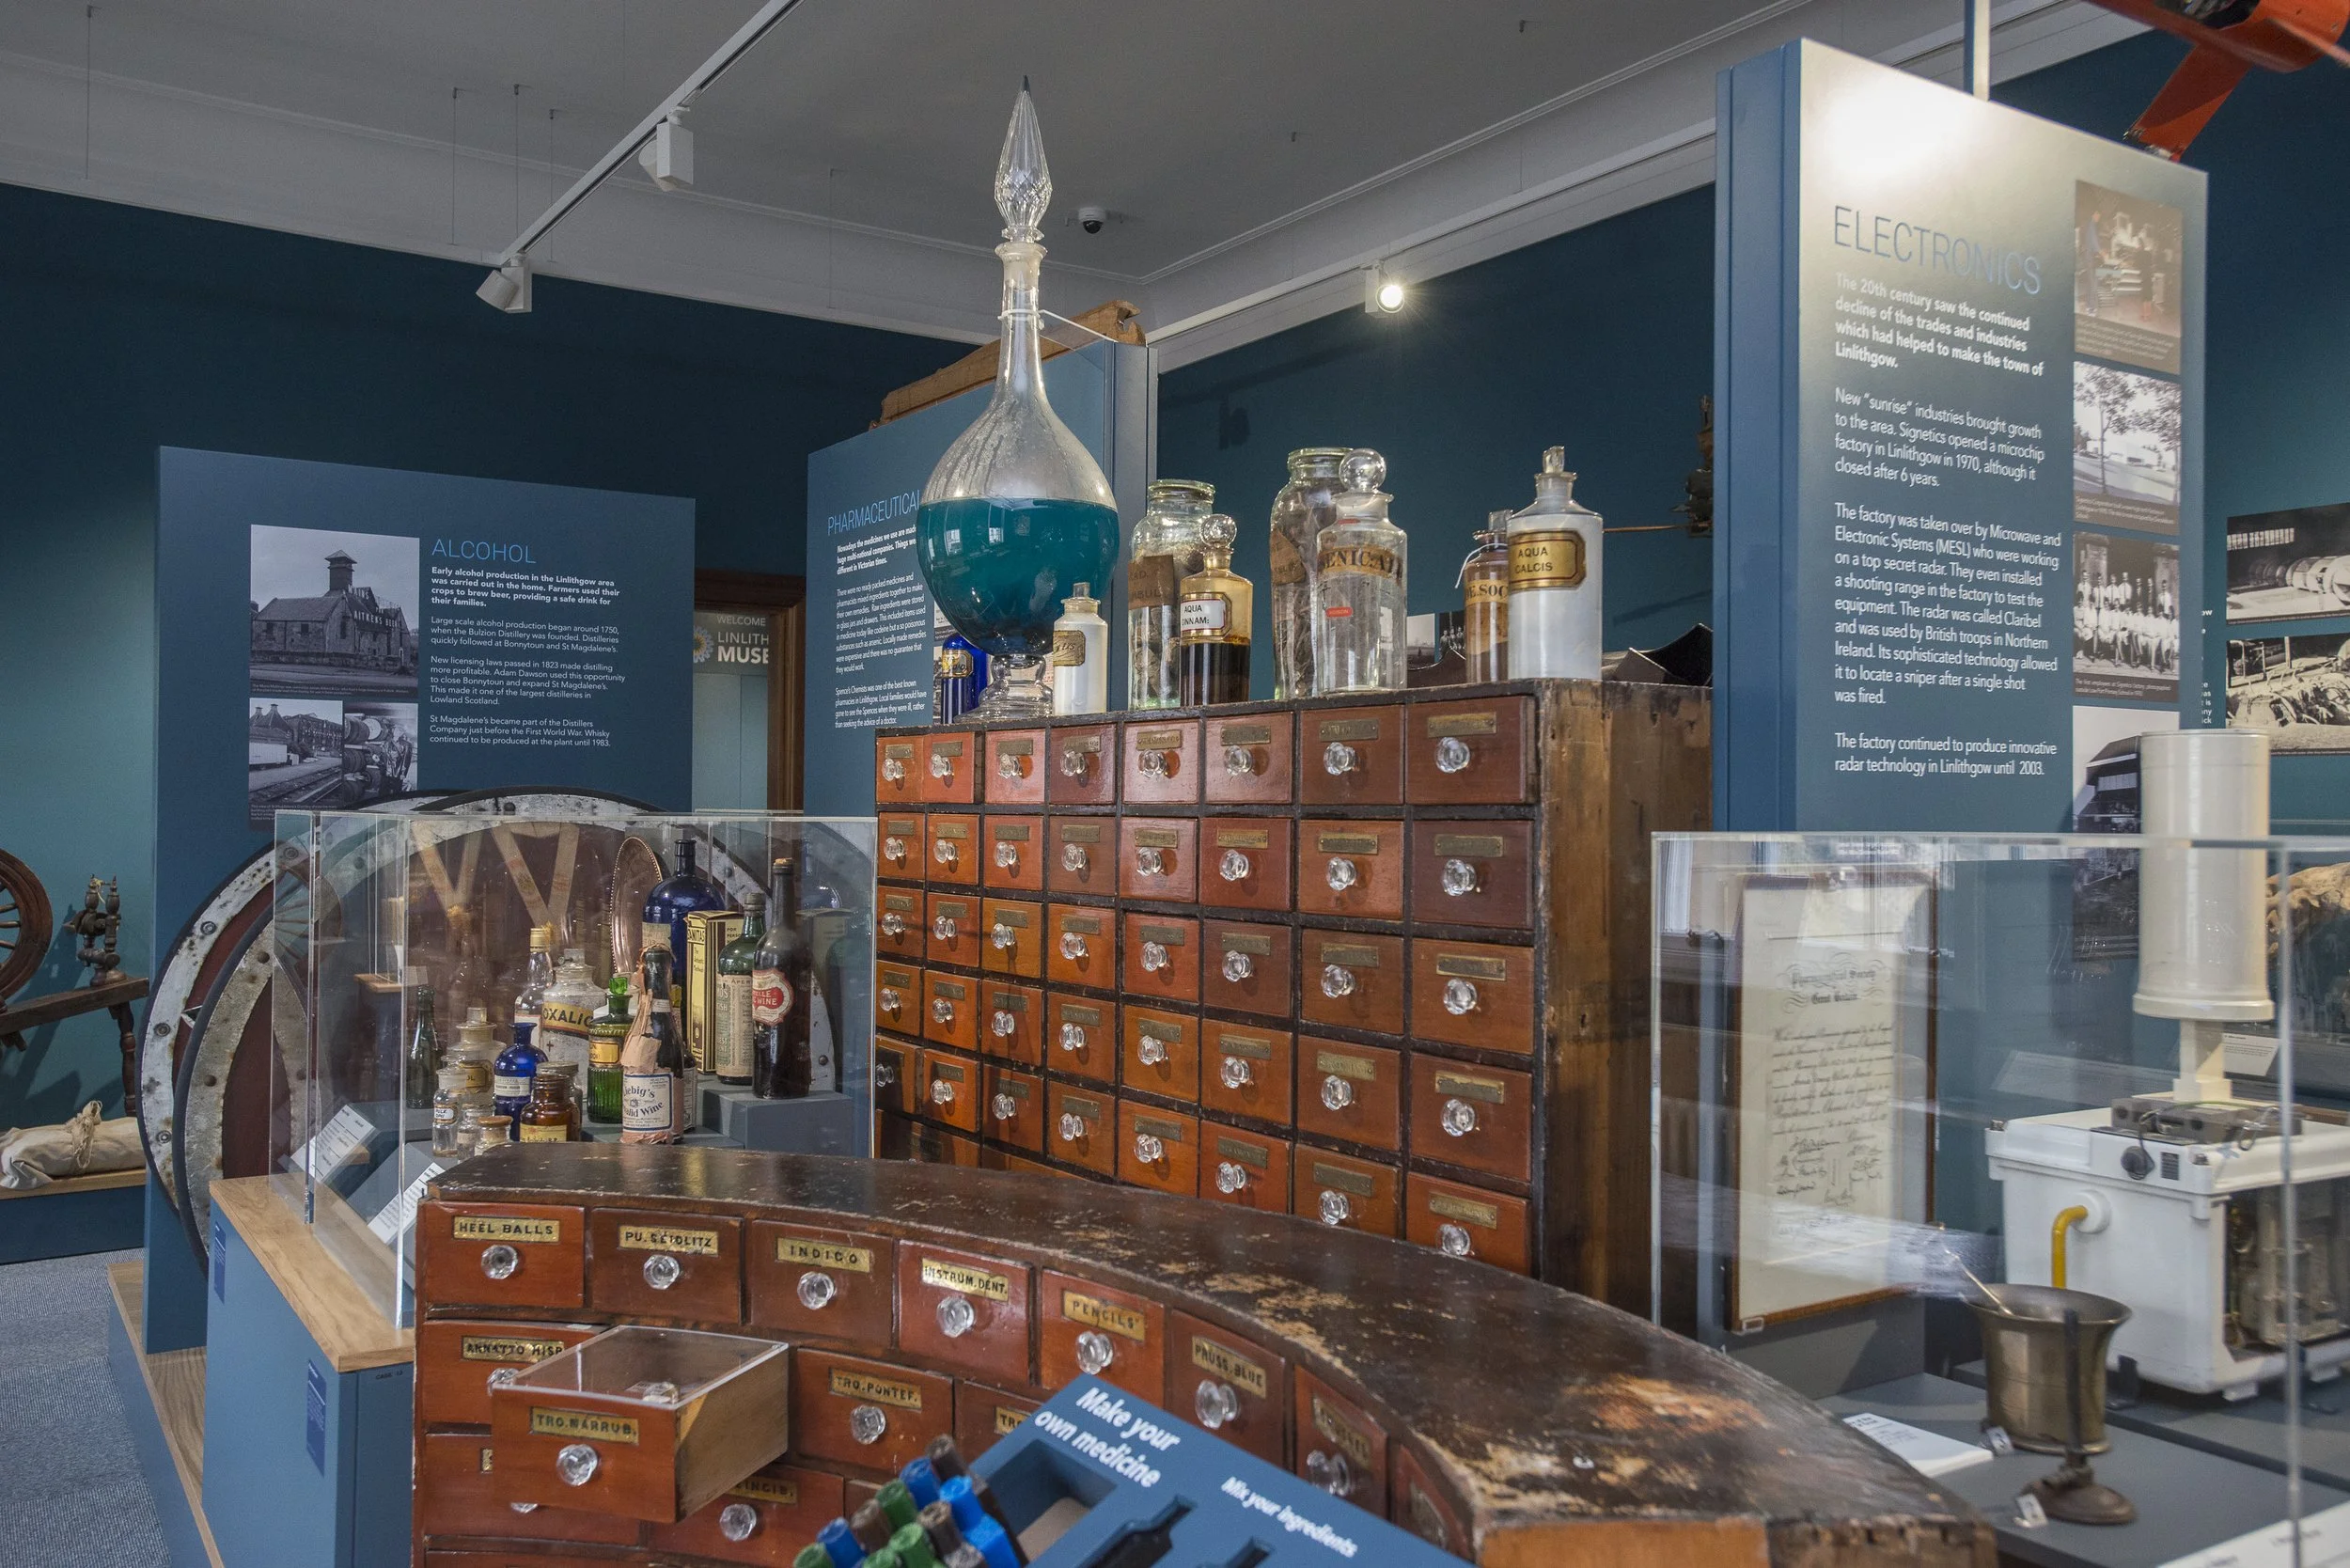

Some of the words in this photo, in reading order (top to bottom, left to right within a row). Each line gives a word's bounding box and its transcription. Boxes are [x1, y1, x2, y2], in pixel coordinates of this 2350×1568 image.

[1834, 204, 2042, 294] ELECTRONICS
[1835, 272, 1856, 290] The
[1860, 278, 1887, 297] 20th
[1889, 290, 1932, 312] century
[1934, 299, 1956, 314] saw
[1957, 301, 1977, 319] the
[1978, 310, 2030, 331] continued
[1835, 297, 1876, 318] decline
[1879, 306, 1892, 321] of
[1894, 308, 1914, 326] the
[1916, 315, 1951, 335] trades
[1953, 324, 1974, 340] and
[1976, 327, 2028, 352] industries
[1835, 321, 1869, 339] which
[1872, 325, 1893, 344] had
[1896, 330, 1935, 353] helped
[1936, 341, 1950, 356] to
[1951, 346, 1981, 363] make
[1982, 350, 2001, 368] the
[2002, 355, 2030, 373] town
[2031, 361, 2044, 376] of
[1835, 342, 1898, 368] Linlithgow.
[1835, 387, 1860, 405] New
[1915, 402, 1965, 425] industries
[1966, 411, 2007, 435] brought
[2007, 424, 2042, 439] growth
[1835, 414, 1847, 426] to
[1849, 413, 1868, 430] the
[1870, 420, 1897, 435] area.
[1899, 421, 1947, 444] Signetics
[1948, 434, 1987, 450] opened
[1989, 442, 1996, 452] a
[1998, 441, 2044, 463] microchip
[1834, 432, 1873, 458] factory
[1874, 440, 1885, 455] in
[1888, 442, 1942, 466] Linlithgow
[1943, 451, 1953, 466] in
[1955, 453, 1982, 474] 1970,
[1983, 458, 2028, 481] although
[2029, 465, 2036, 480] it
[1834, 457, 1872, 476] closed
[1873, 463, 1899, 479] after
[1900, 466, 1908, 481] 6
[1909, 472, 1939, 487] years.
[431, 539, 536, 564] ALCOHOL
[837, 542, 856, 553] Nowadays
[864, 535, 883, 546] medicines
[1517, 546, 1549, 558] AQUA
[431, 567, 453, 576] Early
[455, 569, 484, 577] alcohol
[486, 572, 529, 580] production
[556, 575, 596, 586] Linlithgow
[837, 566, 854, 574] different
[857, 560, 875, 570] Victorian
[1514, 562, 1554, 574] CALCIS
[431, 588, 454, 597] crops
[467, 588, 489, 597] brew
[491, 590, 510, 599] beer,
[513, 593, 551, 604] providing
[577, 596, 598, 604] drink
[449, 578, 478, 587] carried
[506, 581, 520, 589] the
[522, 582, 546, 591] home.
[548, 585, 580, 593] Farmers
[602, 588, 619, 596] their
[431, 596, 451, 604] their
[453, 597, 487, 606] families.
[1183, 604, 1202, 614] AQUA
[431, 616, 453, 626] Large
[476, 619, 504, 627] alcohol
[505, 620, 546, 630] production
[548, 622, 572, 633] began
[601, 625, 619, 635] 1750,
[716, 615, 766, 626] WELCOME
[431, 626, 452, 635] when
[497, 630, 531, 640] Distillery
[547, 633, 580, 641] founded.
[582, 634, 619, 643] Distilleries
[431, 636, 458, 646] quickly
[460, 637, 493, 646] followed
[504, 640, 544, 650] Bonnytoun
[717, 631, 769, 645] LINLITH
[1834, 731, 1856, 748] The
[1858, 732, 1896, 754] factory
[1897, 736, 1950, 751] continued
[1951, 739, 1964, 751] to
[1965, 737, 2007, 755] produce
[2008, 739, 2057, 754] innovative
[1835, 755, 1864, 771] radar
[1866, 756, 1926, 776] technology
[1928, 759, 1938, 773] in
[1940, 758, 1992, 777] Linlithgow
[1993, 760, 2014, 775] until
[2019, 760, 2044, 775] 2003.
[542, 1008, 593, 1027] OXALIC
[640, 1102, 664, 1117] Wine
[459, 1221, 495, 1233] HEEL
[503, 1224, 554, 1235] BALLS
[1075, 1387, 1132, 1427] Make
[1120, 1417, 1182, 1451] your
[1034, 1411, 1078, 1442] own
[1072, 1431, 1162, 1488] medicine
[1221, 1476, 1250, 1501] Mix
[1242, 1492, 1281, 1517] your
[1277, 1505, 1358, 1558] ingredients
